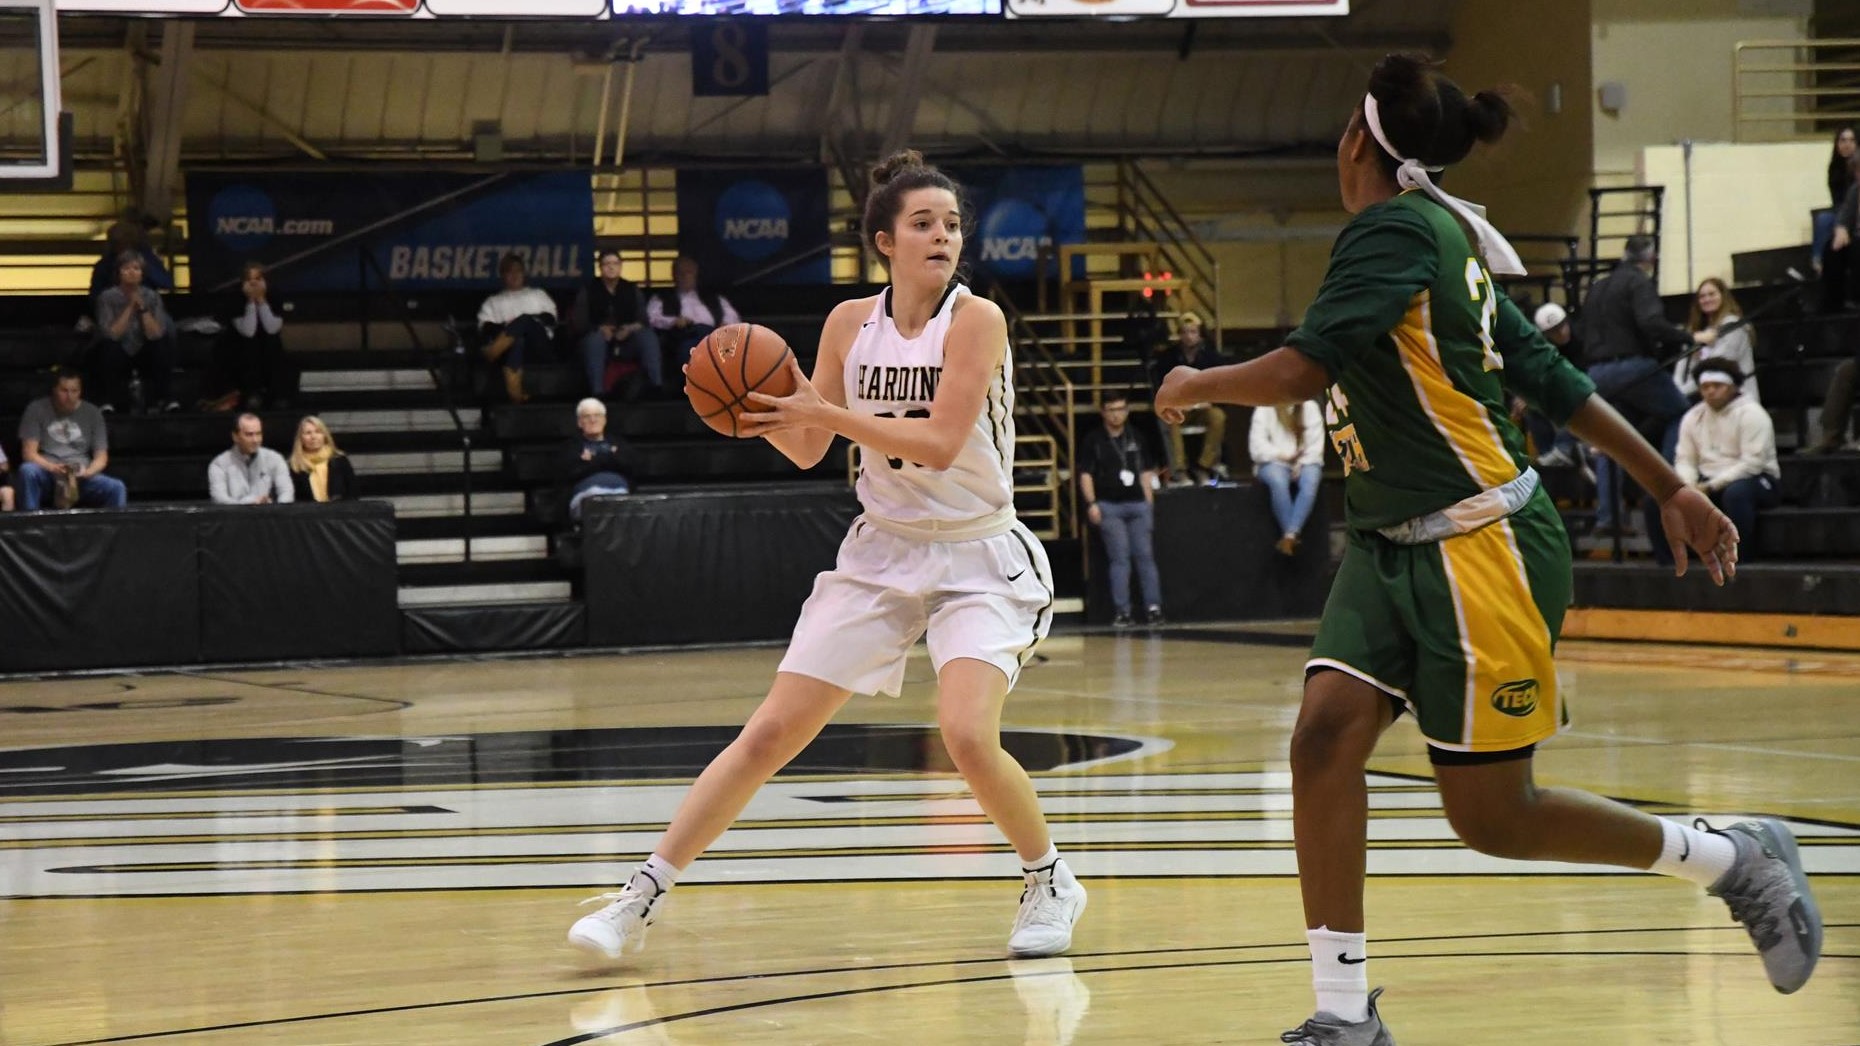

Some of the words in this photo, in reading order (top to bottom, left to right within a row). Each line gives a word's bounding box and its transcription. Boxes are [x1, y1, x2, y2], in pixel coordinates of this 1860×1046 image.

[712, 21, 750, 88] 8
[723, 219, 789, 239] NCAA
[858, 365, 943, 402] HARDIN
